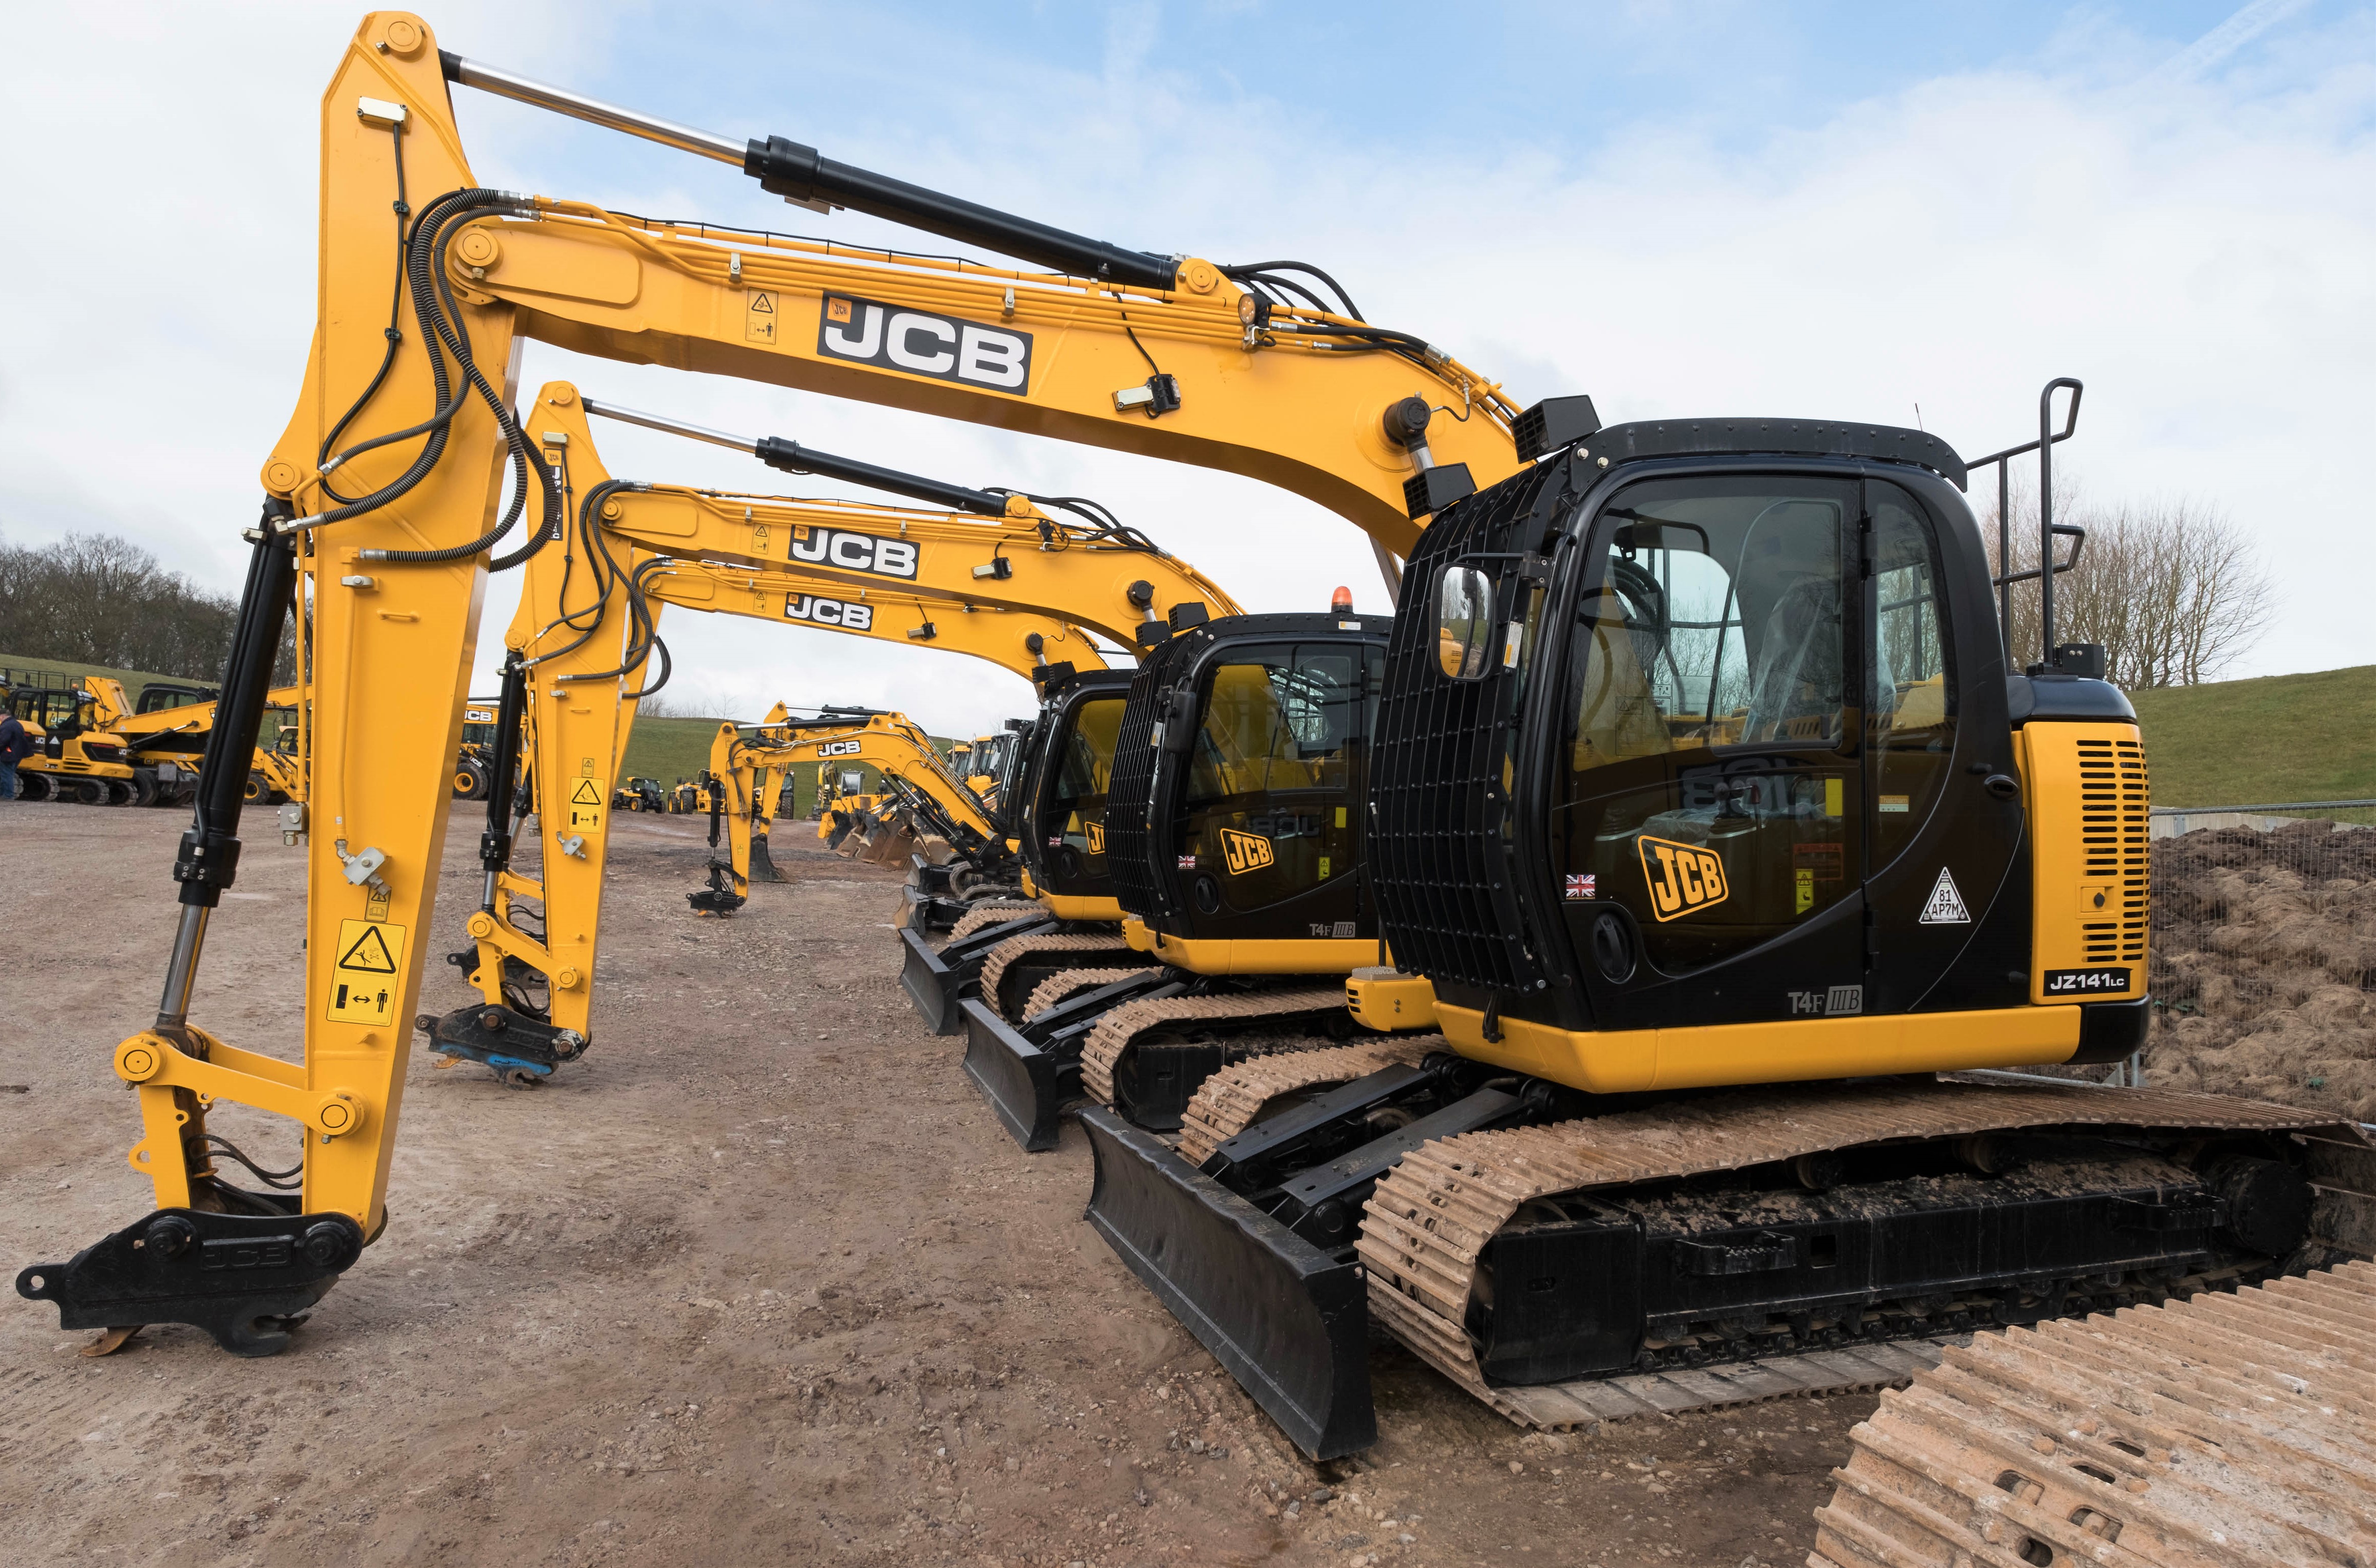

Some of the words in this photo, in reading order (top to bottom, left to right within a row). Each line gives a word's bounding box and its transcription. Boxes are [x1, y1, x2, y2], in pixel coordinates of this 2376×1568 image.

[835, 304, 847, 314] JCB
[825, 305, 1026, 387] JCB
[792, 529, 916, 576] JCB
[787, 596, 871, 629] JCB
[818, 741, 861, 756] JCB
[470, 758, 483, 767] JCB
[1229, 833, 1270, 870] JCB
[1655, 845, 1723, 911] JCB
[1939, 890, 1951, 902] 81
[1932, 903, 1959, 916] AP7M
[1309, 924, 1332, 936] T4F
[1787, 991, 1825, 1014] T4F
